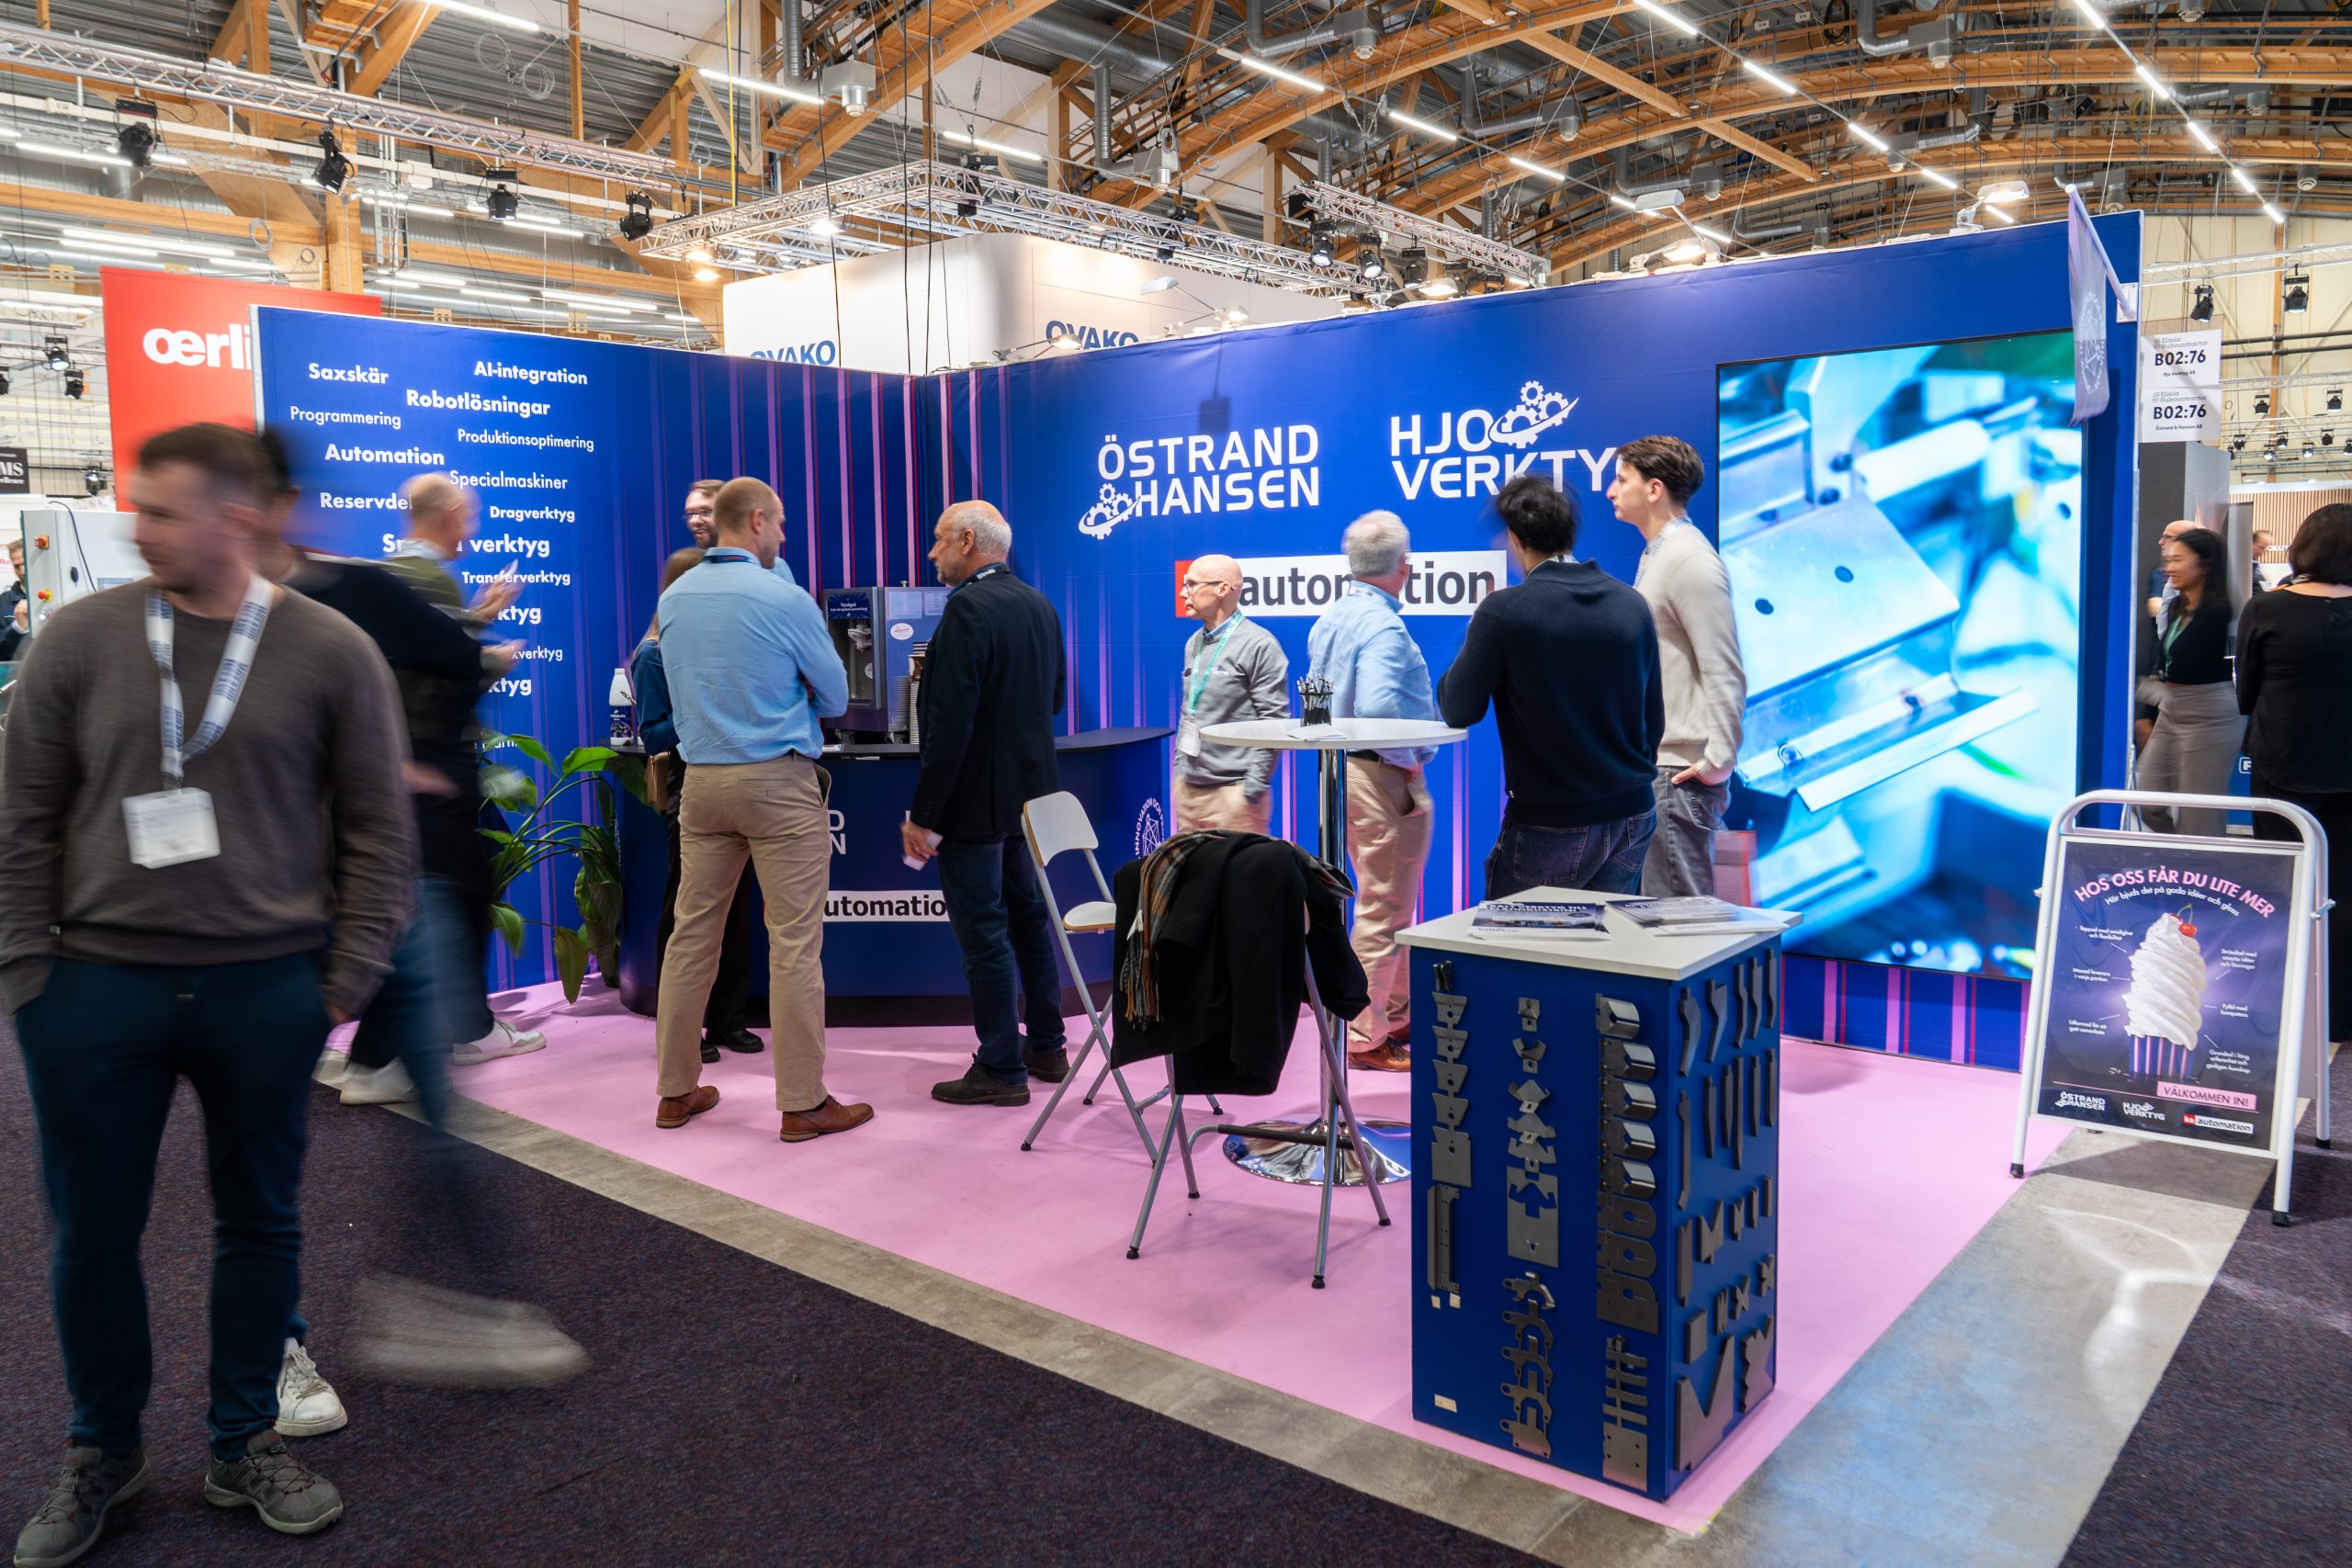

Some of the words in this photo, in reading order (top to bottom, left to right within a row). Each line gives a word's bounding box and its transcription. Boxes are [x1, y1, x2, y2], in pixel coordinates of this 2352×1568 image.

[2155, 349, 2206, 366] B02:76
[309, 362, 388, 384] Saxskär
[474, 361, 588, 385] AI-integration
[406, 389, 550, 419] Robotlösningar
[2154, 404, 2207, 419] B02:76
[290, 406, 401, 430] Programmering
[458, 429, 594, 452] Produktionsoptimering
[1391, 410, 1493, 456] HJO
[325, 444, 445, 465] Automation
[1098, 424, 1318, 479] ÖSTRAND
[449, 470, 568, 491] Specialmaskiner
[1391, 447, 1617, 500] VERKTY
[320, 492, 413, 511] Reservdel
[1136, 467, 1319, 516] HANSEN
[490, 506, 575, 523] Dragverktyg
[470, 534, 550, 558] verktyg
[498, 605, 541, 625] ktyg
[512, 646, 562, 661] kverktyg
[2075, 877, 2109, 902] HOS
[2111, 869, 2144, 887] OSS
[2148, 865, 2178, 884] FÅR
[2182, 871, 2208, 887] DU
[2210, 876, 2241, 898] LITE
[2239, 889, 2276, 919] MER
[2105, 893, 2120, 906] Här
[2119, 888, 2141, 900] bjuds
[2141, 886, 2154, 895] det
[2154, 886, 2165, 897] på
[2165, 886, 2187, 896] goda
[2207, 897, 2222, 906] och
[2221, 902, 2240, 917] glass
[824, 895, 946, 917] utomatio
[2060, 1091, 2105, 1104] ÖSTRAND
[2068, 1100, 2105, 1111] HANSEN
[2123, 1102, 2143, 1111] HJO
[2163, 1086, 2231, 1104] VÄLKOMMEN
[2233, 1097, 2249, 1107] IN!
[2123, 1109, 2165, 1121] VERKTYG
[2198, 1117, 2251, 1132] automation
